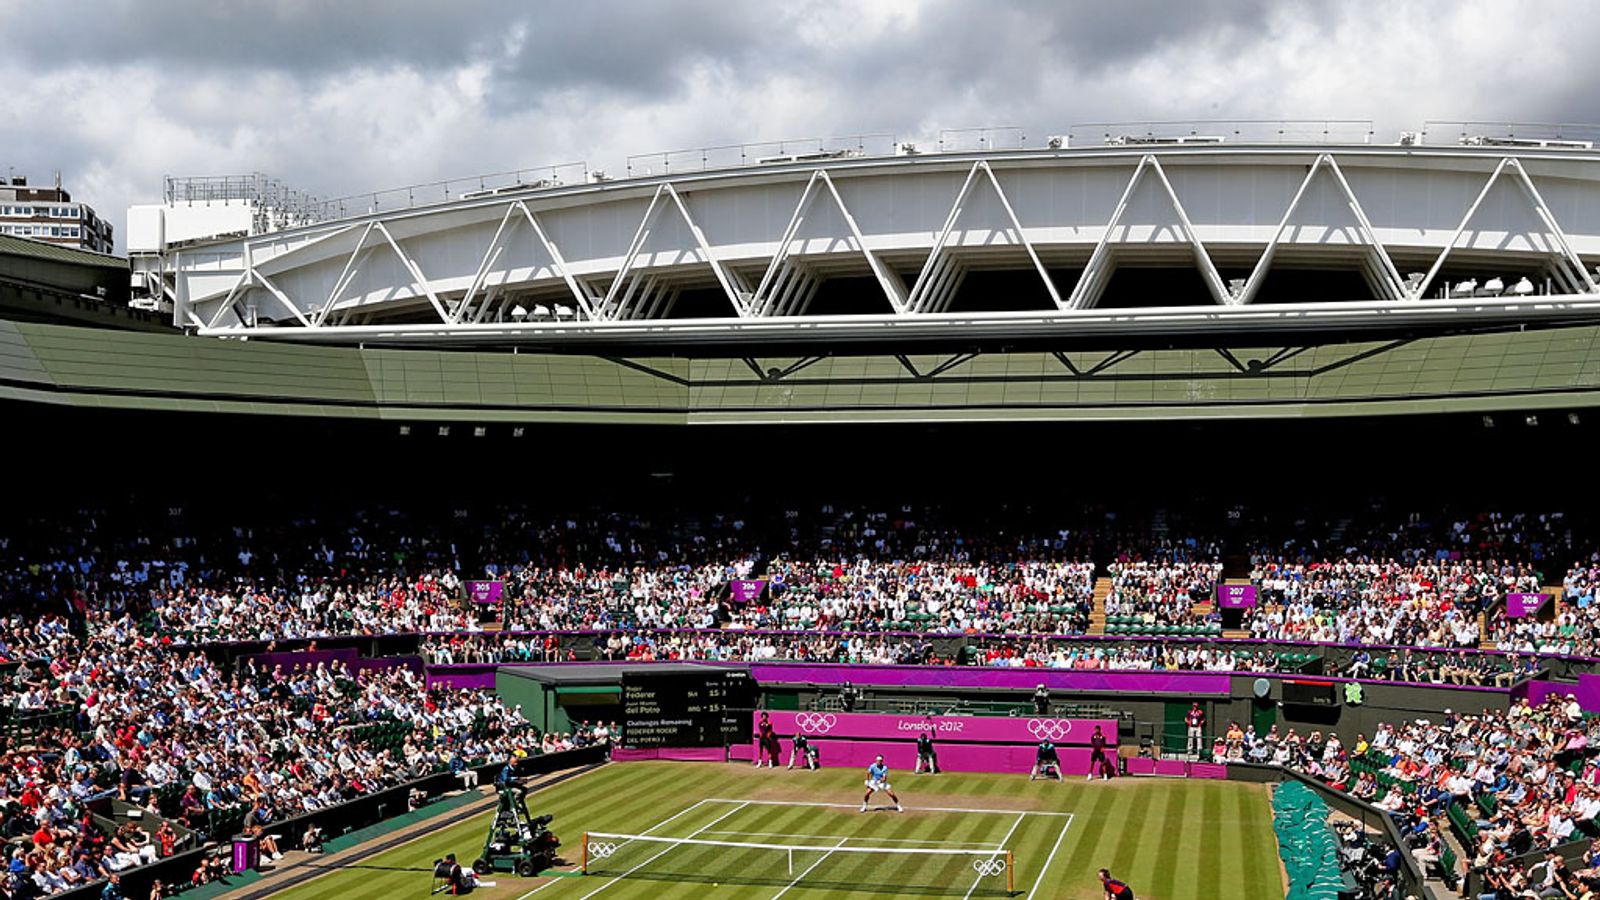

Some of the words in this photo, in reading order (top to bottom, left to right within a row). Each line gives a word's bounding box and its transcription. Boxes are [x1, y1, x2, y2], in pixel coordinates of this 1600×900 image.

[476, 583, 490, 591] 205
[1522, 595, 1538, 604] 208
[709, 704, 720, 712] 15
[898, 720, 937, 731] London
[939, 721, 964, 732] 2012
